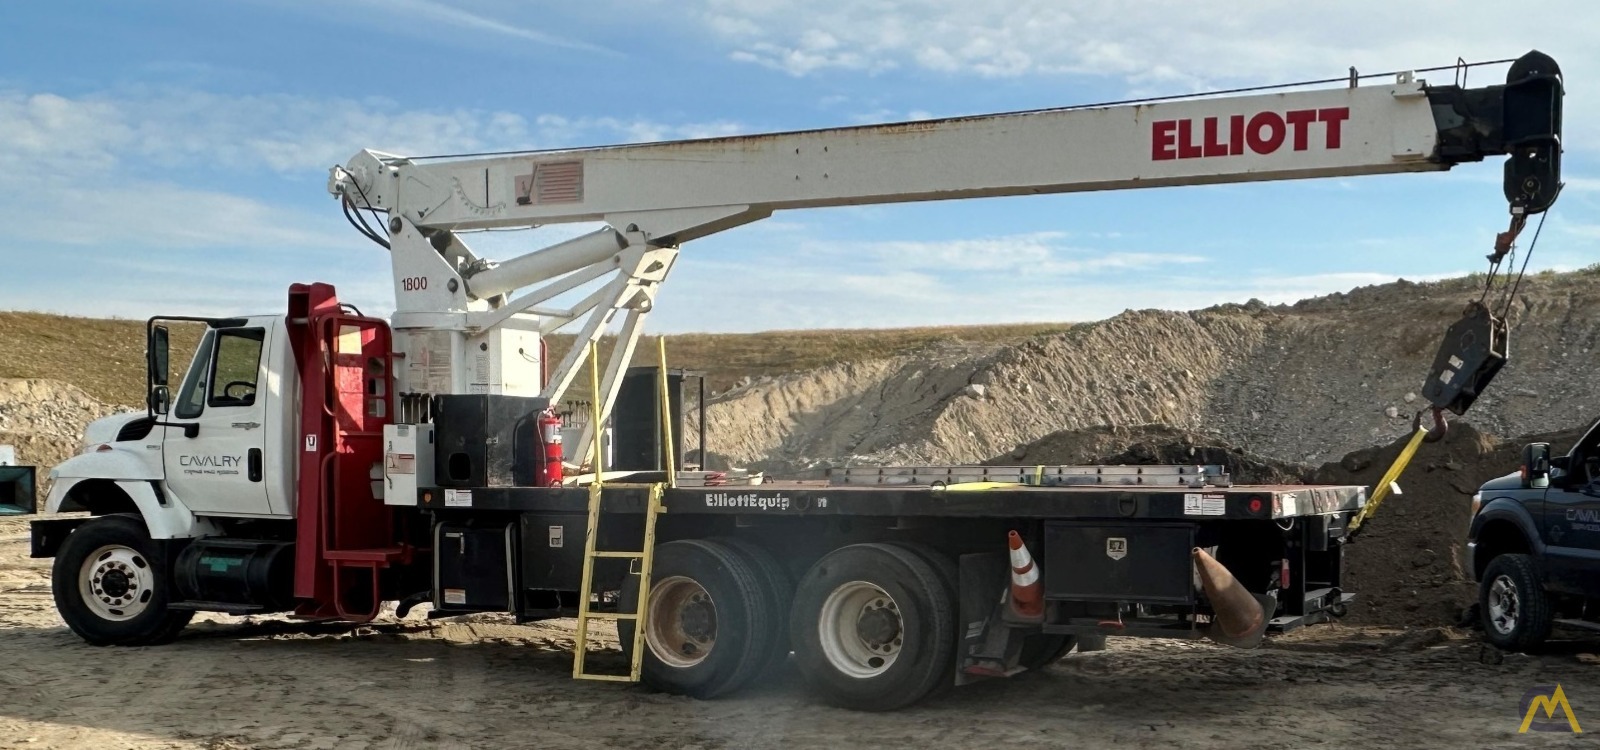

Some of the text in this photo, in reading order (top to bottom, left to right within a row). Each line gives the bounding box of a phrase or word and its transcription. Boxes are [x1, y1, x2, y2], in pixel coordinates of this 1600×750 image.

[1152, 107, 1349, 161] ELLIOTT
[401, 276, 427, 291] 1800
[180, 455, 241, 467] CAVALRY
